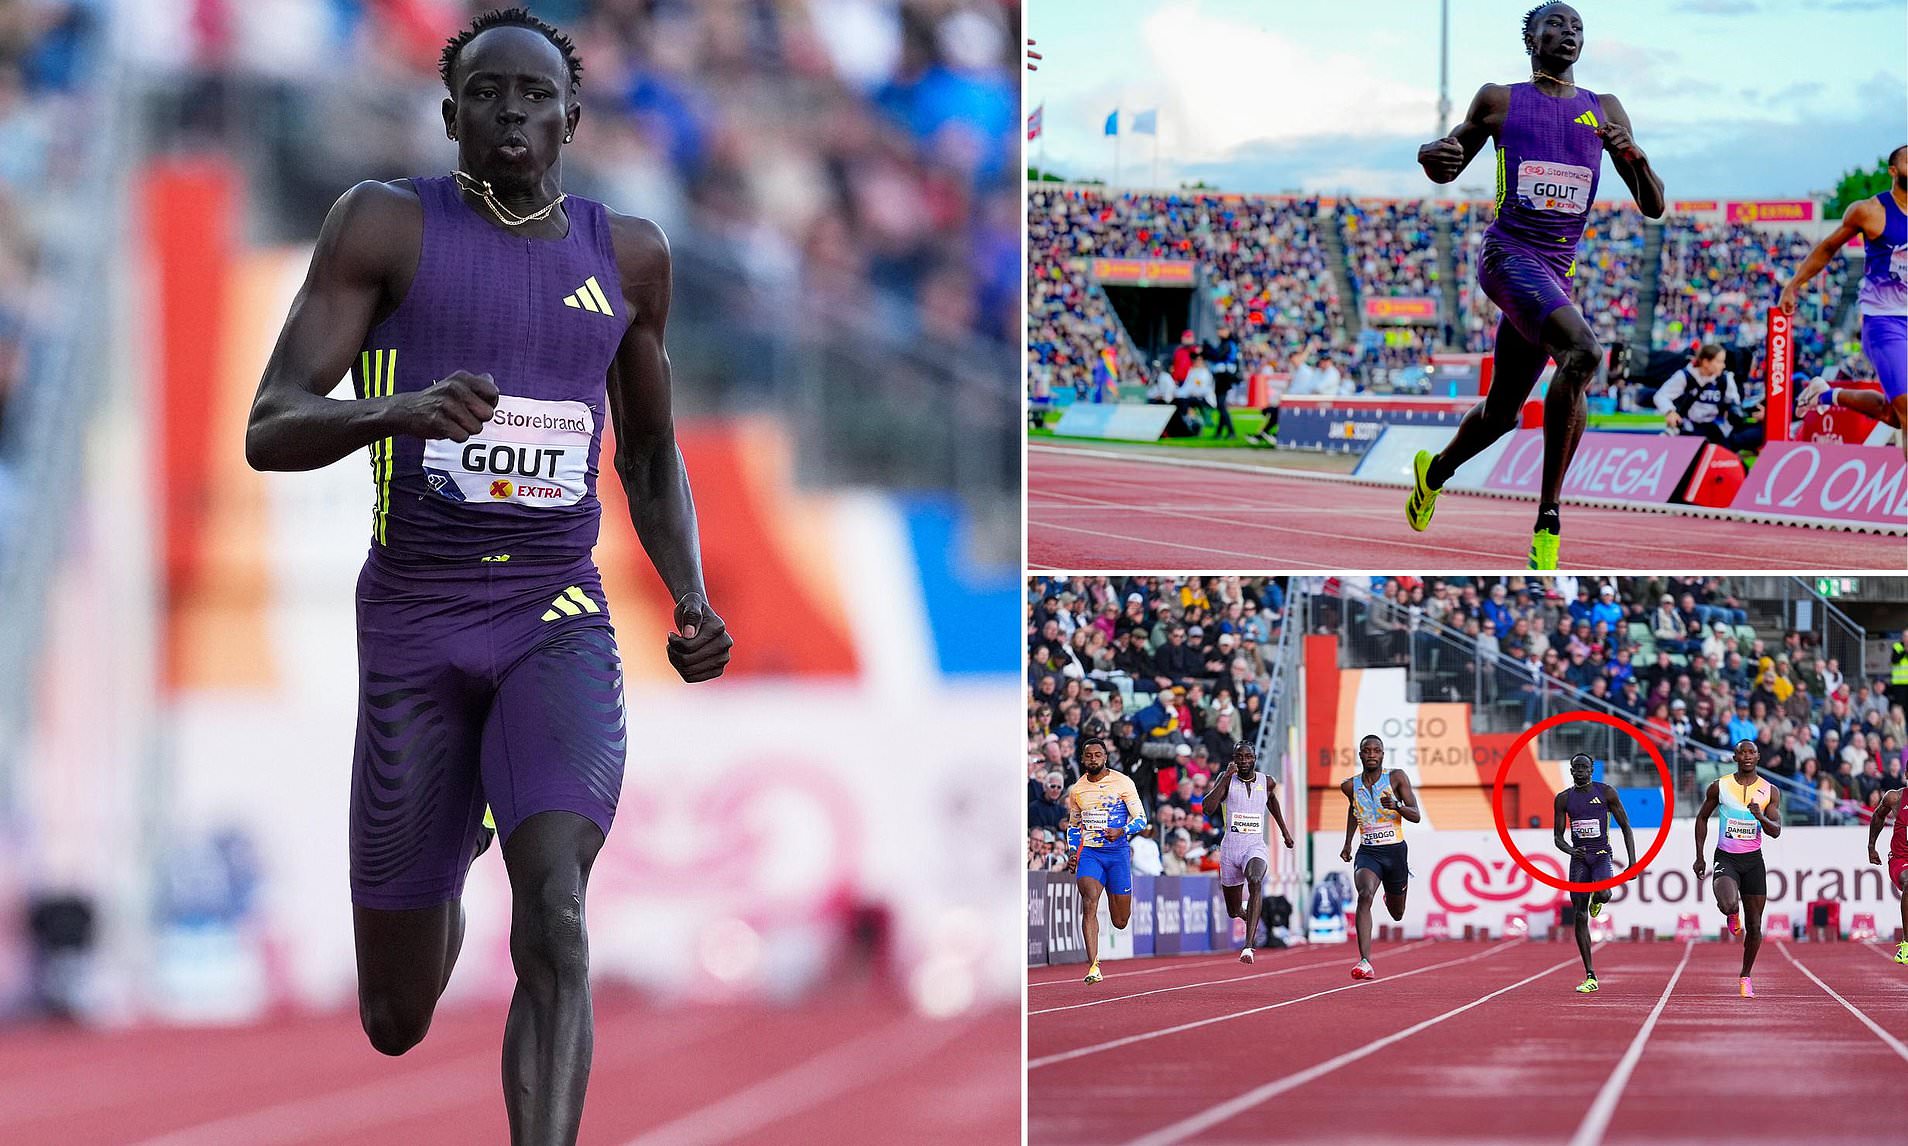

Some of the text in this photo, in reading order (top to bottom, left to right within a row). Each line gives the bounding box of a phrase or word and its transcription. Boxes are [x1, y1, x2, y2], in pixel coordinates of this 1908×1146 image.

[1534, 183, 1578, 200] GOUT
[1771, 335, 1786, 397] OMEGA
[493, 409, 587, 432] Storebrand
[461, 443, 565, 478] GOUT
[1563, 447, 1669, 497] MEGA
[517, 485, 562, 499] EXTRA
[1382, 717, 1447, 739] OSLO
[1319, 746, 1397, 768] BISLT
[1727, 826, 1756, 835] DAMBILE
